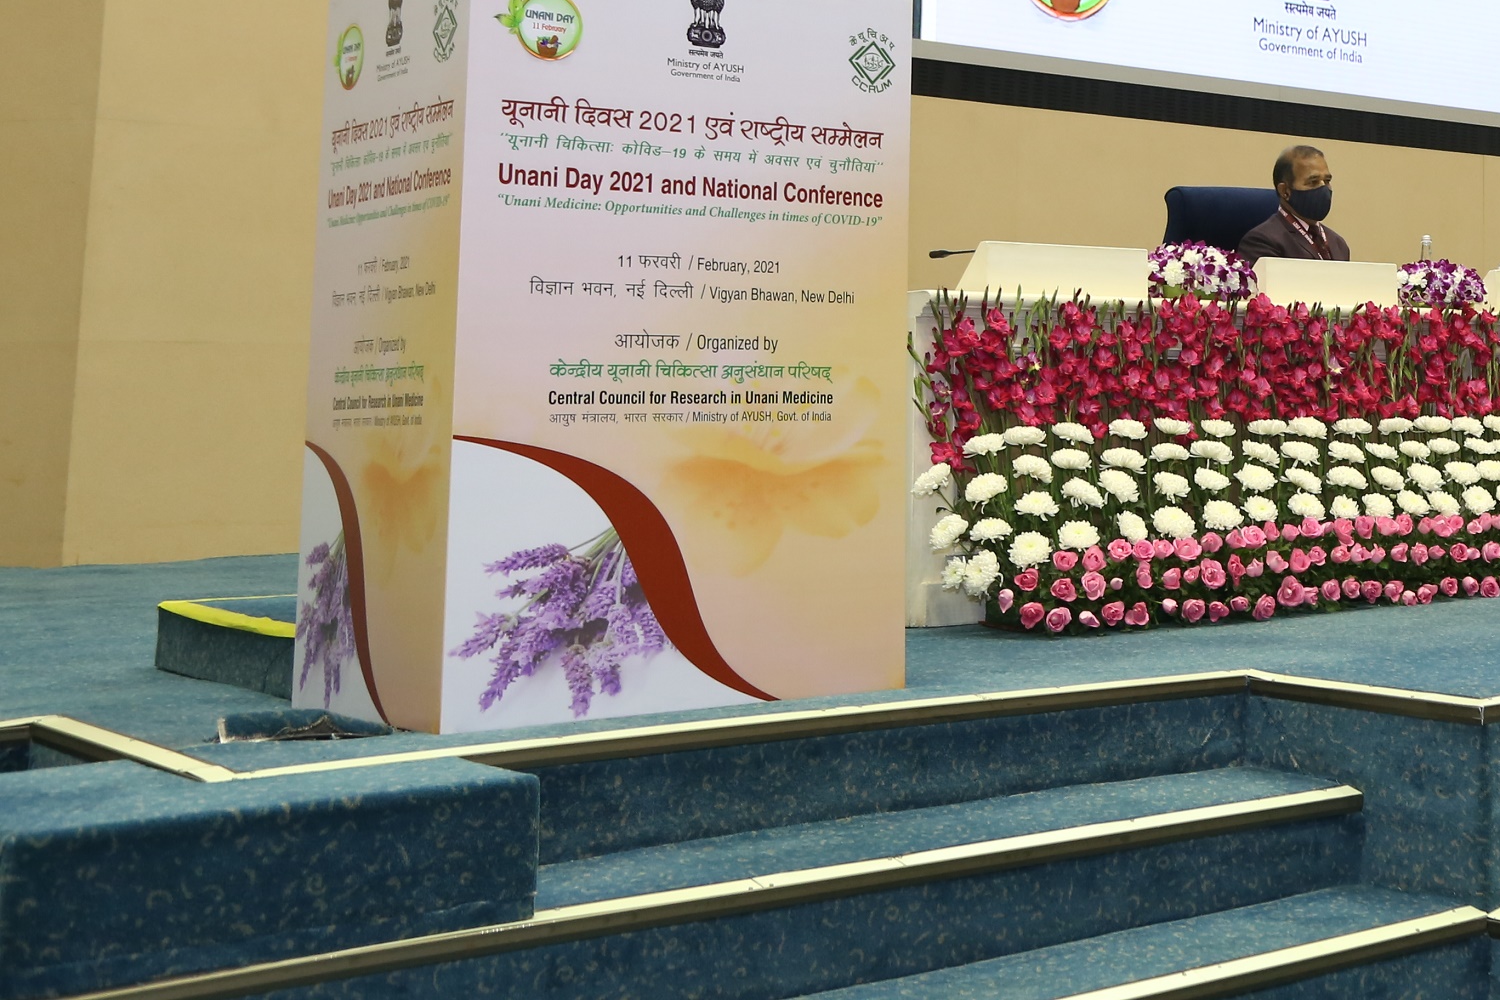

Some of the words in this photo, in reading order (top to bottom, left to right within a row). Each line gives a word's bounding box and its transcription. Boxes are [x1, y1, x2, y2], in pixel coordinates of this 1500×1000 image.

[526, 9, 553, 21] UNANI
[557, 13, 575, 24] DAY
[1284, 0, 1314, 16] सत्यमेव
[1316, 4, 1336, 20] जयते
[532, 22, 540, 30] 11
[542, 24, 566, 33] February
[1253, 17, 1303, 42] Ministry
[1306, 26, 1318, 40] of
[1322, 27, 1367, 47] AYUSH
[1259, 37, 1324, 58] Government
[1326, 48, 1336, 60] of
[1340, 49, 1362, 63] India
[667, 57, 700, 71] Ministry
[702, 62, 712, 70] of
[713, 62, 745, 74] AYUSH
[670, 68, 714, 80] Government
[851, 75, 893, 93] CCRUM
[369, 117, 388, 139] 2021
[501, 96, 569, 128] यूनानी
[575, 98, 634, 129] दिवस
[639, 110, 695, 134] 2021
[705, 112, 735, 140] एवं
[740, 116, 806, 146] राष्ट्रीय
[811, 121, 884, 149] सम्मेलन
[694, 145, 706, 159] के
[713, 150, 741, 162] समय
[748, 150, 758, 164] में
[764, 153, 800, 167] अवसर
[806, 156, 822, 169] एवं
[328, 187, 345, 208] Unani
[346, 186, 357, 209] Day
[358, 181, 372, 202] 2021
[374, 178, 386, 199] and
[386, 172, 412, 196] National
[413, 168, 451, 192] Conference
[498, 162, 558, 187] Unani
[565, 167, 604, 195] Day
[610, 170, 653, 193] 2021
[661, 176, 696, 196] and
[703, 176, 778, 201] National
[783, 182, 883, 208] Conference
[544, 197, 602, 211] Medicine:
[605, 200, 683, 216] Opportunities
[685, 205, 706, 216] and
[709, 206, 766, 222] Challenges
[768, 210, 778, 220] in
[782, 212, 808, 222] times
[812, 213, 824, 226] of
[618, 255, 632, 268] 11
[638, 252, 682, 270] फरवरी
[697, 257, 750, 276] February,
[753, 260, 780, 274] 2021
[529, 275, 574, 296] विज्ञान
[581, 282, 617, 298] भवन,
[625, 279, 646, 299] नई
[653, 280, 694, 299] दिल्ली
[709, 286, 748, 304] Vigyan
[751, 287, 798, 304] Bhawan,
[801, 290, 825, 304] New
[828, 290, 855, 304] Delhi
[614, 329, 680, 349] आयोजक
[697, 334, 760, 354] Organized
[764, 336, 778, 354] by
[607, 359, 652, 383] यूनानी
[655, 359, 719, 378] चिकित्सा
[721, 360, 785, 384] अनुसंधान
[548, 390, 595, 405] Central
[599, 390, 646, 405] Council
[650, 390, 666, 404] for
[670, 390, 727, 405] Research
[730, 390, 741, 404] in
[745, 390, 779, 405] Unani
[782, 390, 833, 405] Medicine
[549, 413, 576, 427] आयुष
[624, 412, 648, 424] भारत
[652, 412, 685, 424] सरकार
[692, 411, 728, 424] Ministry
[730, 411, 739, 422] of
[741, 411, 774, 423] AYUSH,
[776, 411, 798, 422] Govt.
[802, 411, 810, 422] of
[812, 411, 832, 422] India
